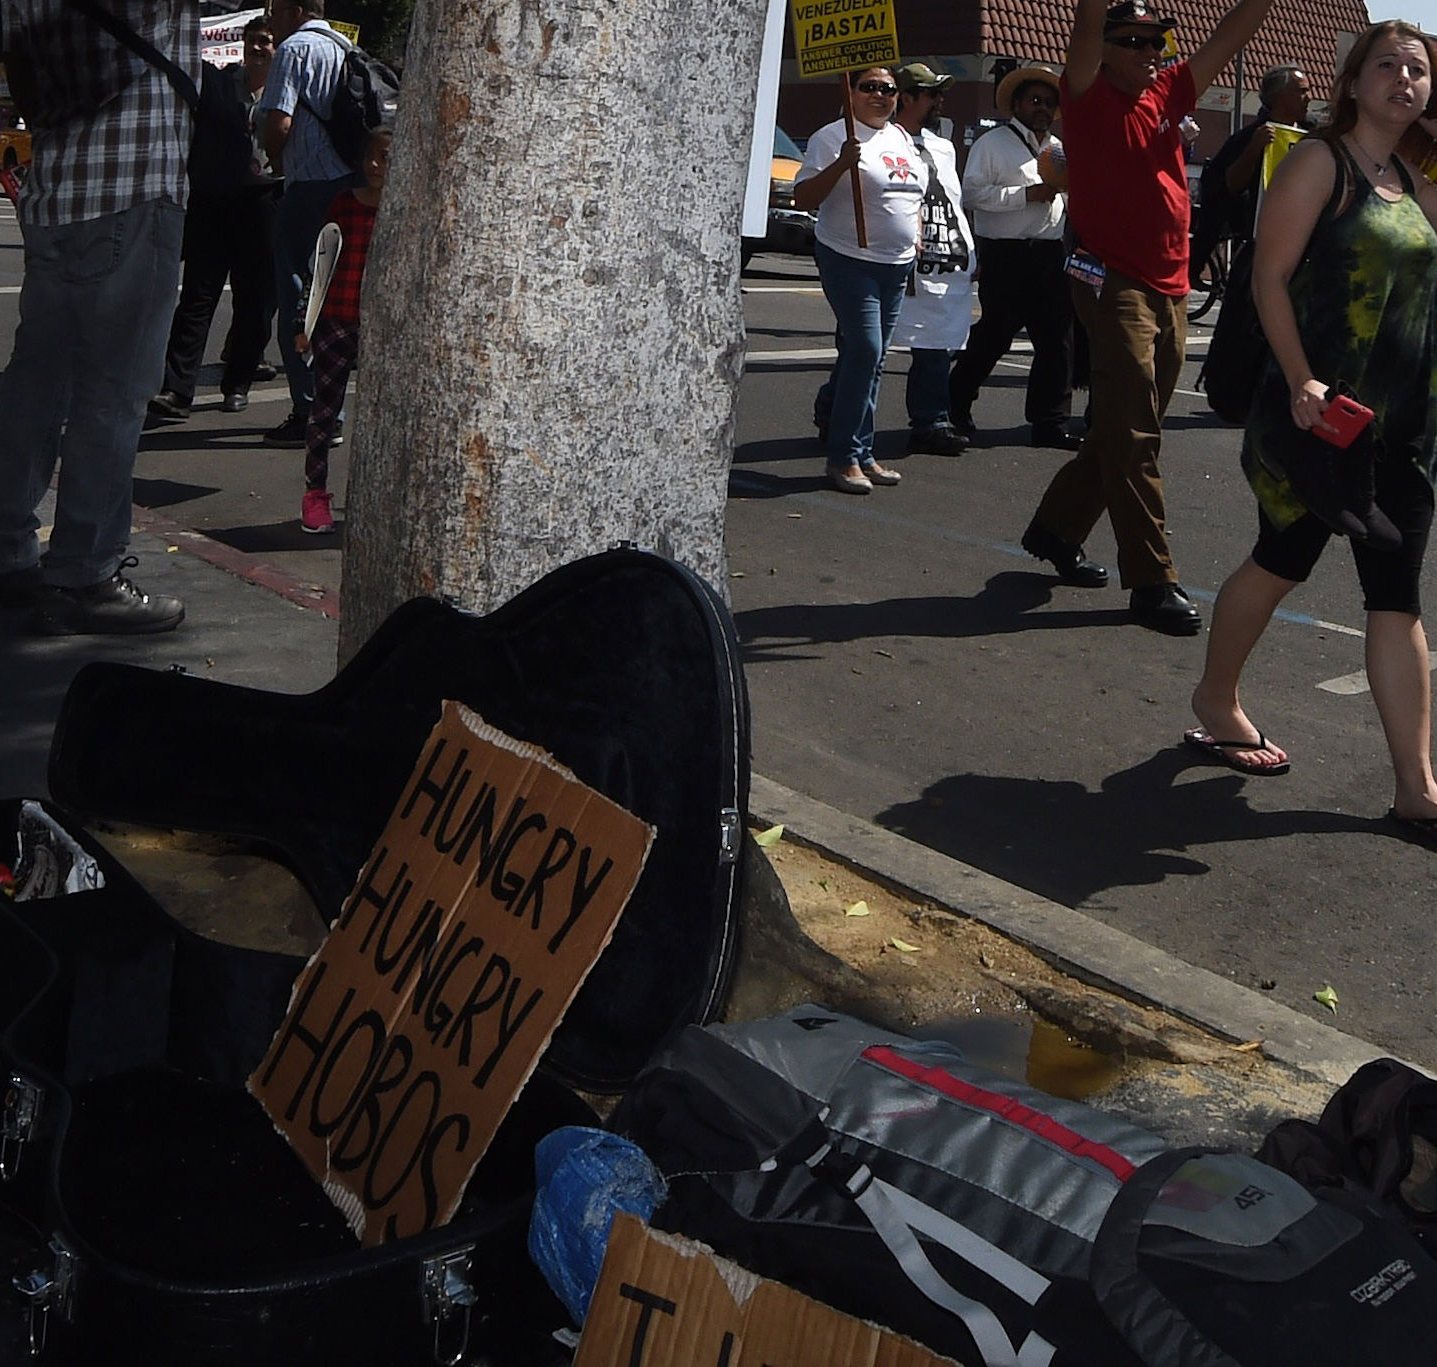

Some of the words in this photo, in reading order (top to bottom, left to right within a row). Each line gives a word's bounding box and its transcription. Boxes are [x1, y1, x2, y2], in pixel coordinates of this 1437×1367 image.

[805, 12, 885, 47] ¡BASTA!
[401, 737, 614, 955] HUNGRY
[341, 847, 544, 1090] HUNGRY
[263, 961, 470, 1238] HOBOS
